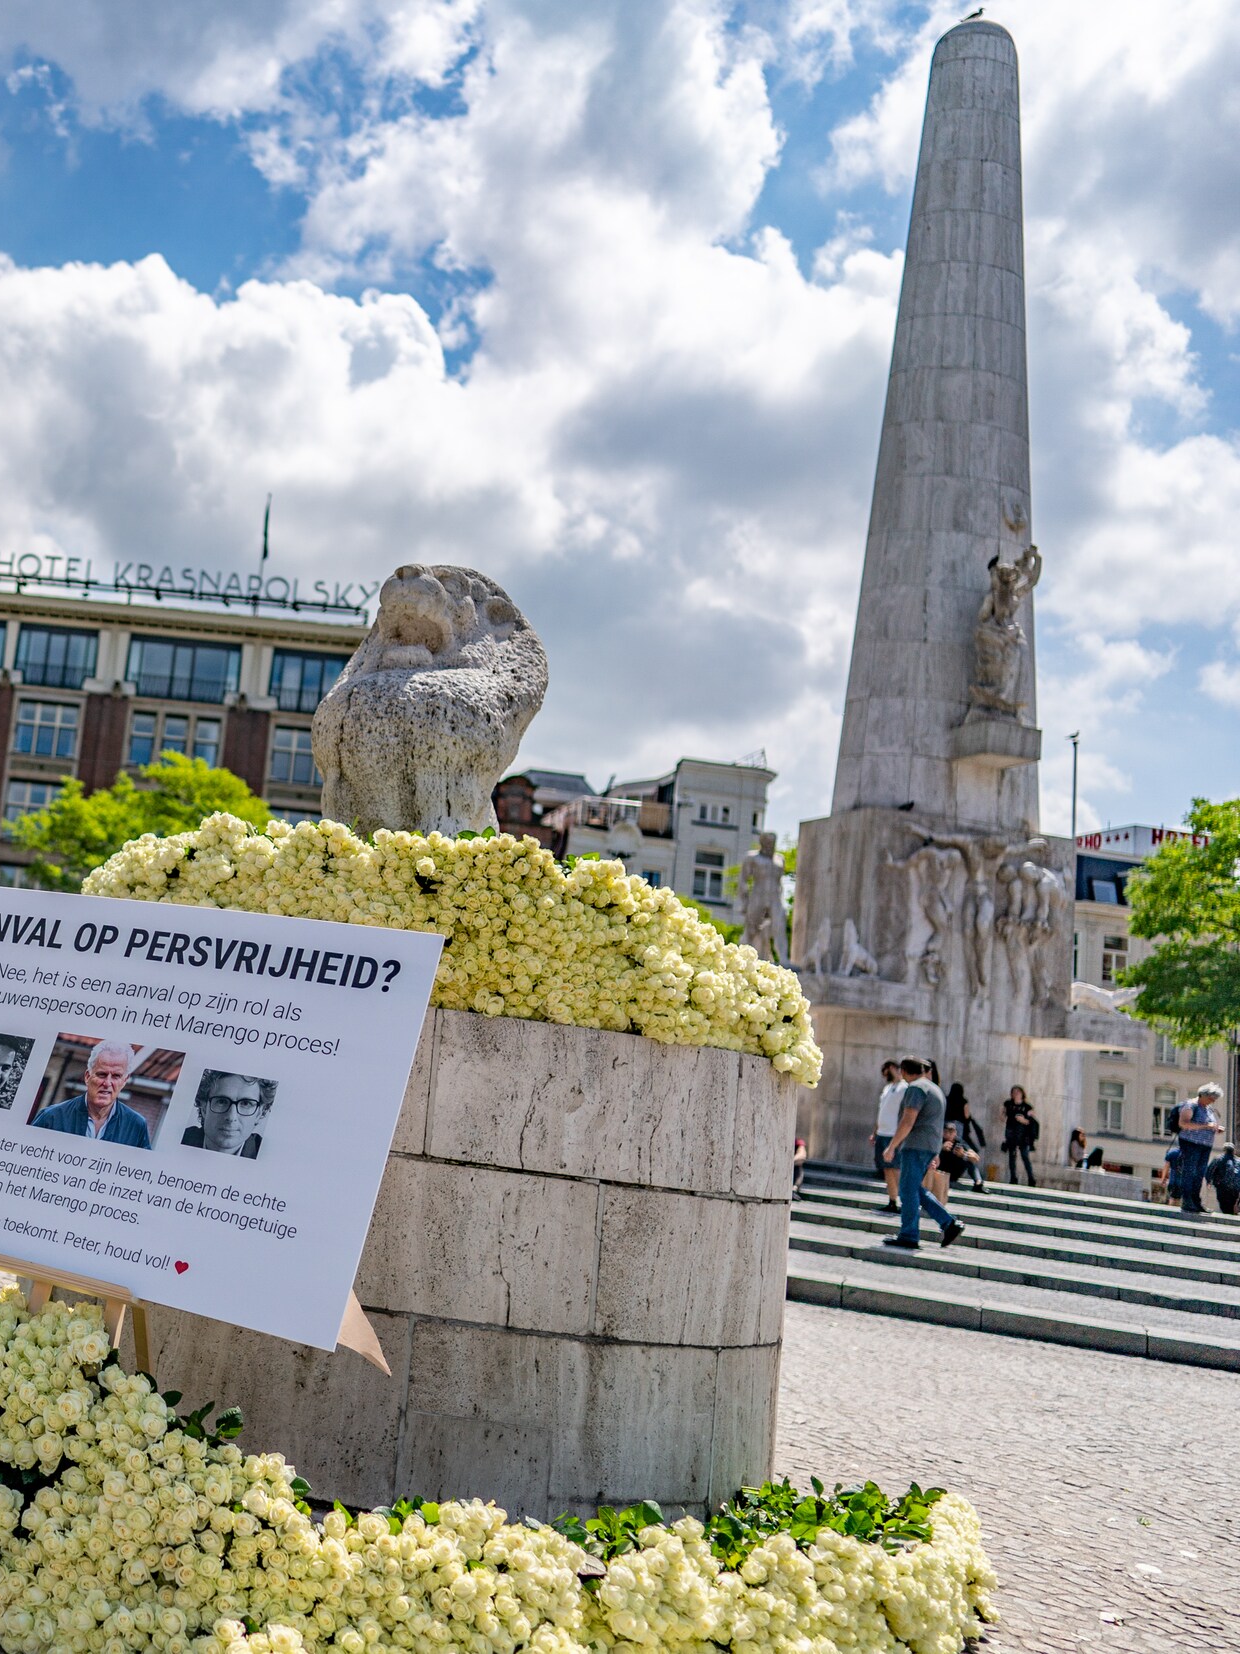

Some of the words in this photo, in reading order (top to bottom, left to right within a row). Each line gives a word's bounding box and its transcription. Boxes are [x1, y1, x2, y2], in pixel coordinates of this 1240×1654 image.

[114, 560, 380, 610] KRASNAPOLSKY
[74, 922, 119, 954] OP
[124, 927, 401, 993] PERSVRIJHEID?
[32, 967, 60, 987] het
[62, 971, 77, 989] is
[80, 977, 111, 994] een
[115, 982, 175, 1004] aanval
[178, 990, 201, 1009] op
[205, 992, 239, 1014] zijn
[243, 999, 270, 1016] rol
[273, 1002, 302, 1021] als
[121, 1005, 137, 1023] in
[141, 1008, 172, 1029] het
[175, 1013, 259, 1045] Marengo
[263, 1031, 340, 1056] proces!
[6, 1180, 28, 1198] het
[29, 1186, 88, 1213] Marengo
[89, 1200, 140, 1225] proces.
[20, 1142, 55, 1161] vecht
[57, 1151, 87, 1168] voor
[88, 1158, 113, 1175] zijn
[115, 1161, 153, 1184] leven,
[157, 1170, 217, 1197] benoem
[220, 1185, 240, 1202] de
[243, 1193, 287, 1212] echte
[63, 1175, 86, 1190] van
[89, 1178, 107, 1194] de
[109, 1182, 143, 1203] inzet
[147, 1192, 172, 1209] van
[175, 1198, 194, 1214] de
[196, 1203, 298, 1240] kroongetuige
[3, 1218, 59, 1243] toekomt.
[63, 1231, 101, 1255] Peter,
[104, 1240, 142, 1264] houd
[145, 1254, 171, 1271] vol!
